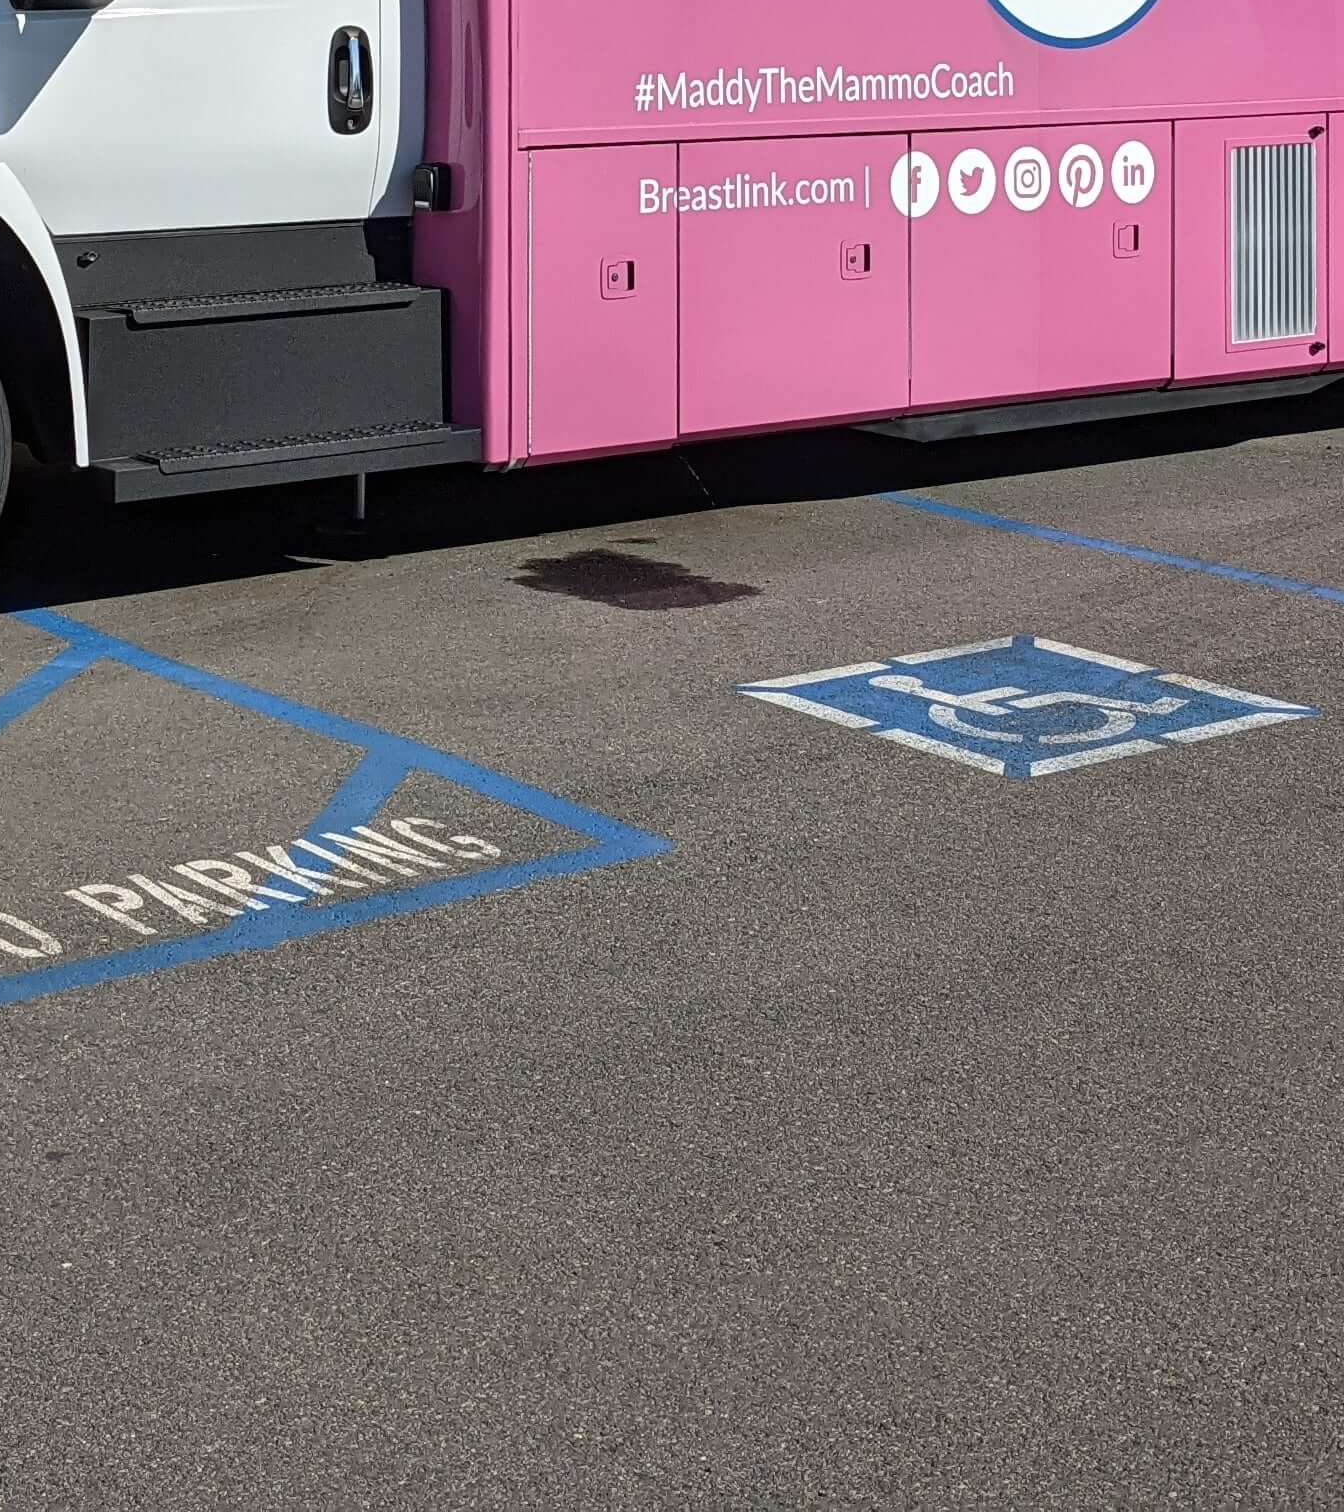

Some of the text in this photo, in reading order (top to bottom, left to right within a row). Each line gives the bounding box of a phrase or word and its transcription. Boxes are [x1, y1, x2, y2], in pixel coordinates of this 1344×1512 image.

[634, 61, 1015, 112] #MaddyTheMammoCoach
[639, 170, 855, 214] Breastlink.com
[64, 817, 502, 936] PARKING
